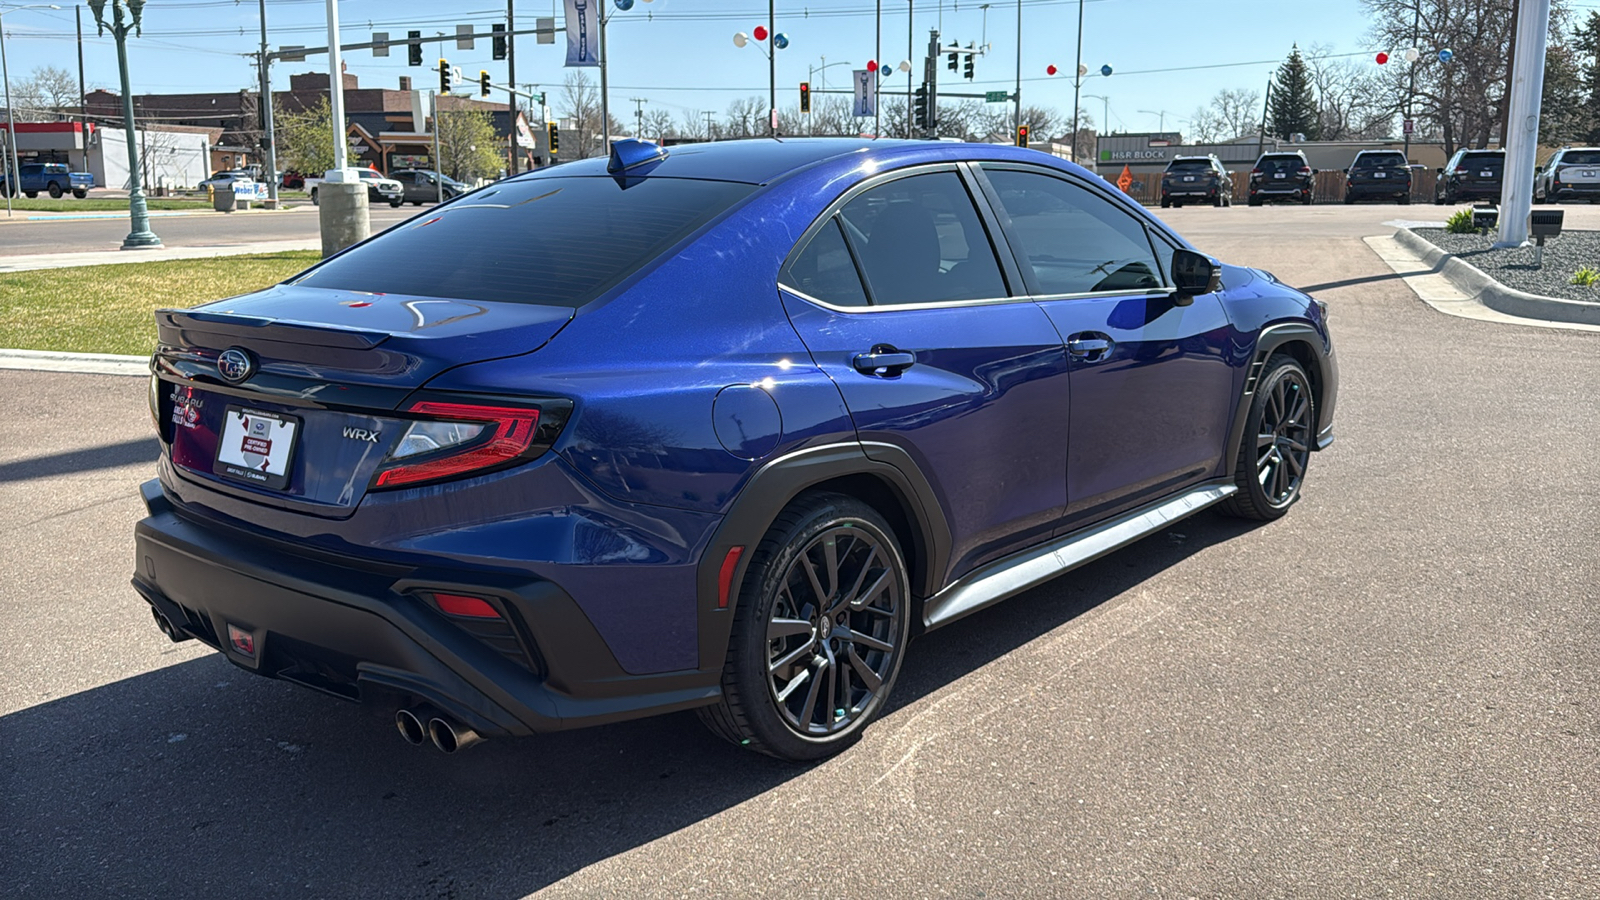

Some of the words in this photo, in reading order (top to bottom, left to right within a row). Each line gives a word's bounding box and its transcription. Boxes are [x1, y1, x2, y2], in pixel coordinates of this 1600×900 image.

[1112, 151, 1132, 159] H&R
[234, 185, 253, 194] Weber
[170, 393, 203, 408] SUBARU
[343, 426, 380, 443] WRX
[247, 438, 268, 447] CERTIFIED
[244, 445, 268, 454] PRE-OWNED
